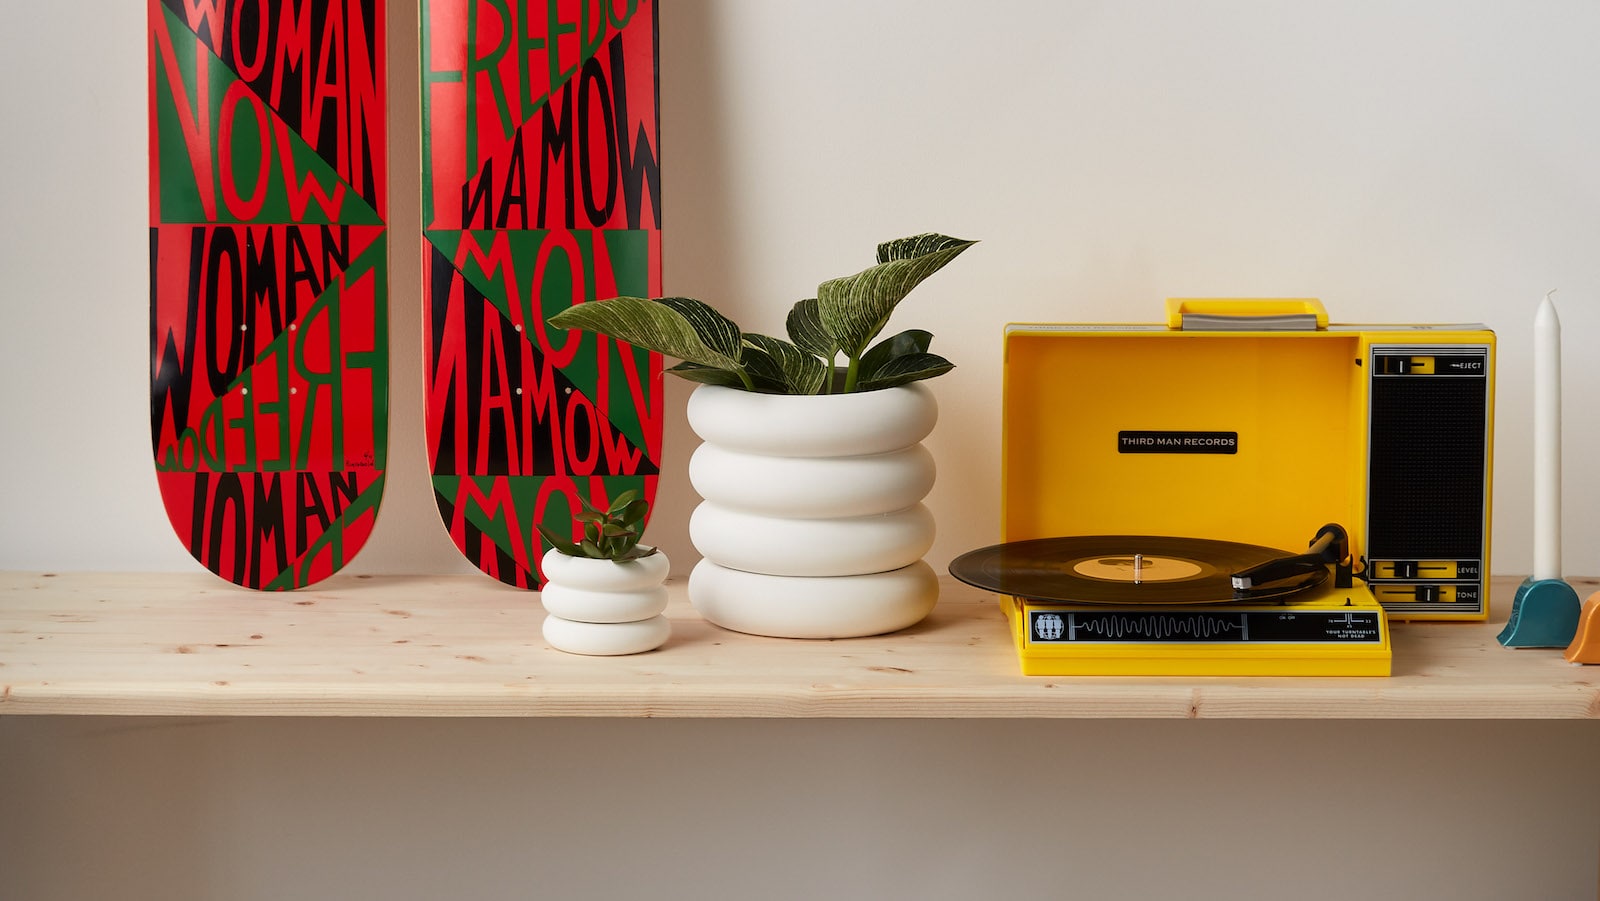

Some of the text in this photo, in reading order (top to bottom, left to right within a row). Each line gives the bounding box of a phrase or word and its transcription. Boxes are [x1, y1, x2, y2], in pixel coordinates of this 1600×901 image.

[148, 0, 347, 223] NOW
[420, 0, 648, 230] FREEDO
[149, 226, 350, 461] WOMAN
[1157, 438, 1181, 446] MAN
[1184, 438, 1235, 446] RECORDS
[1457, 591, 1477, 599] TONE
